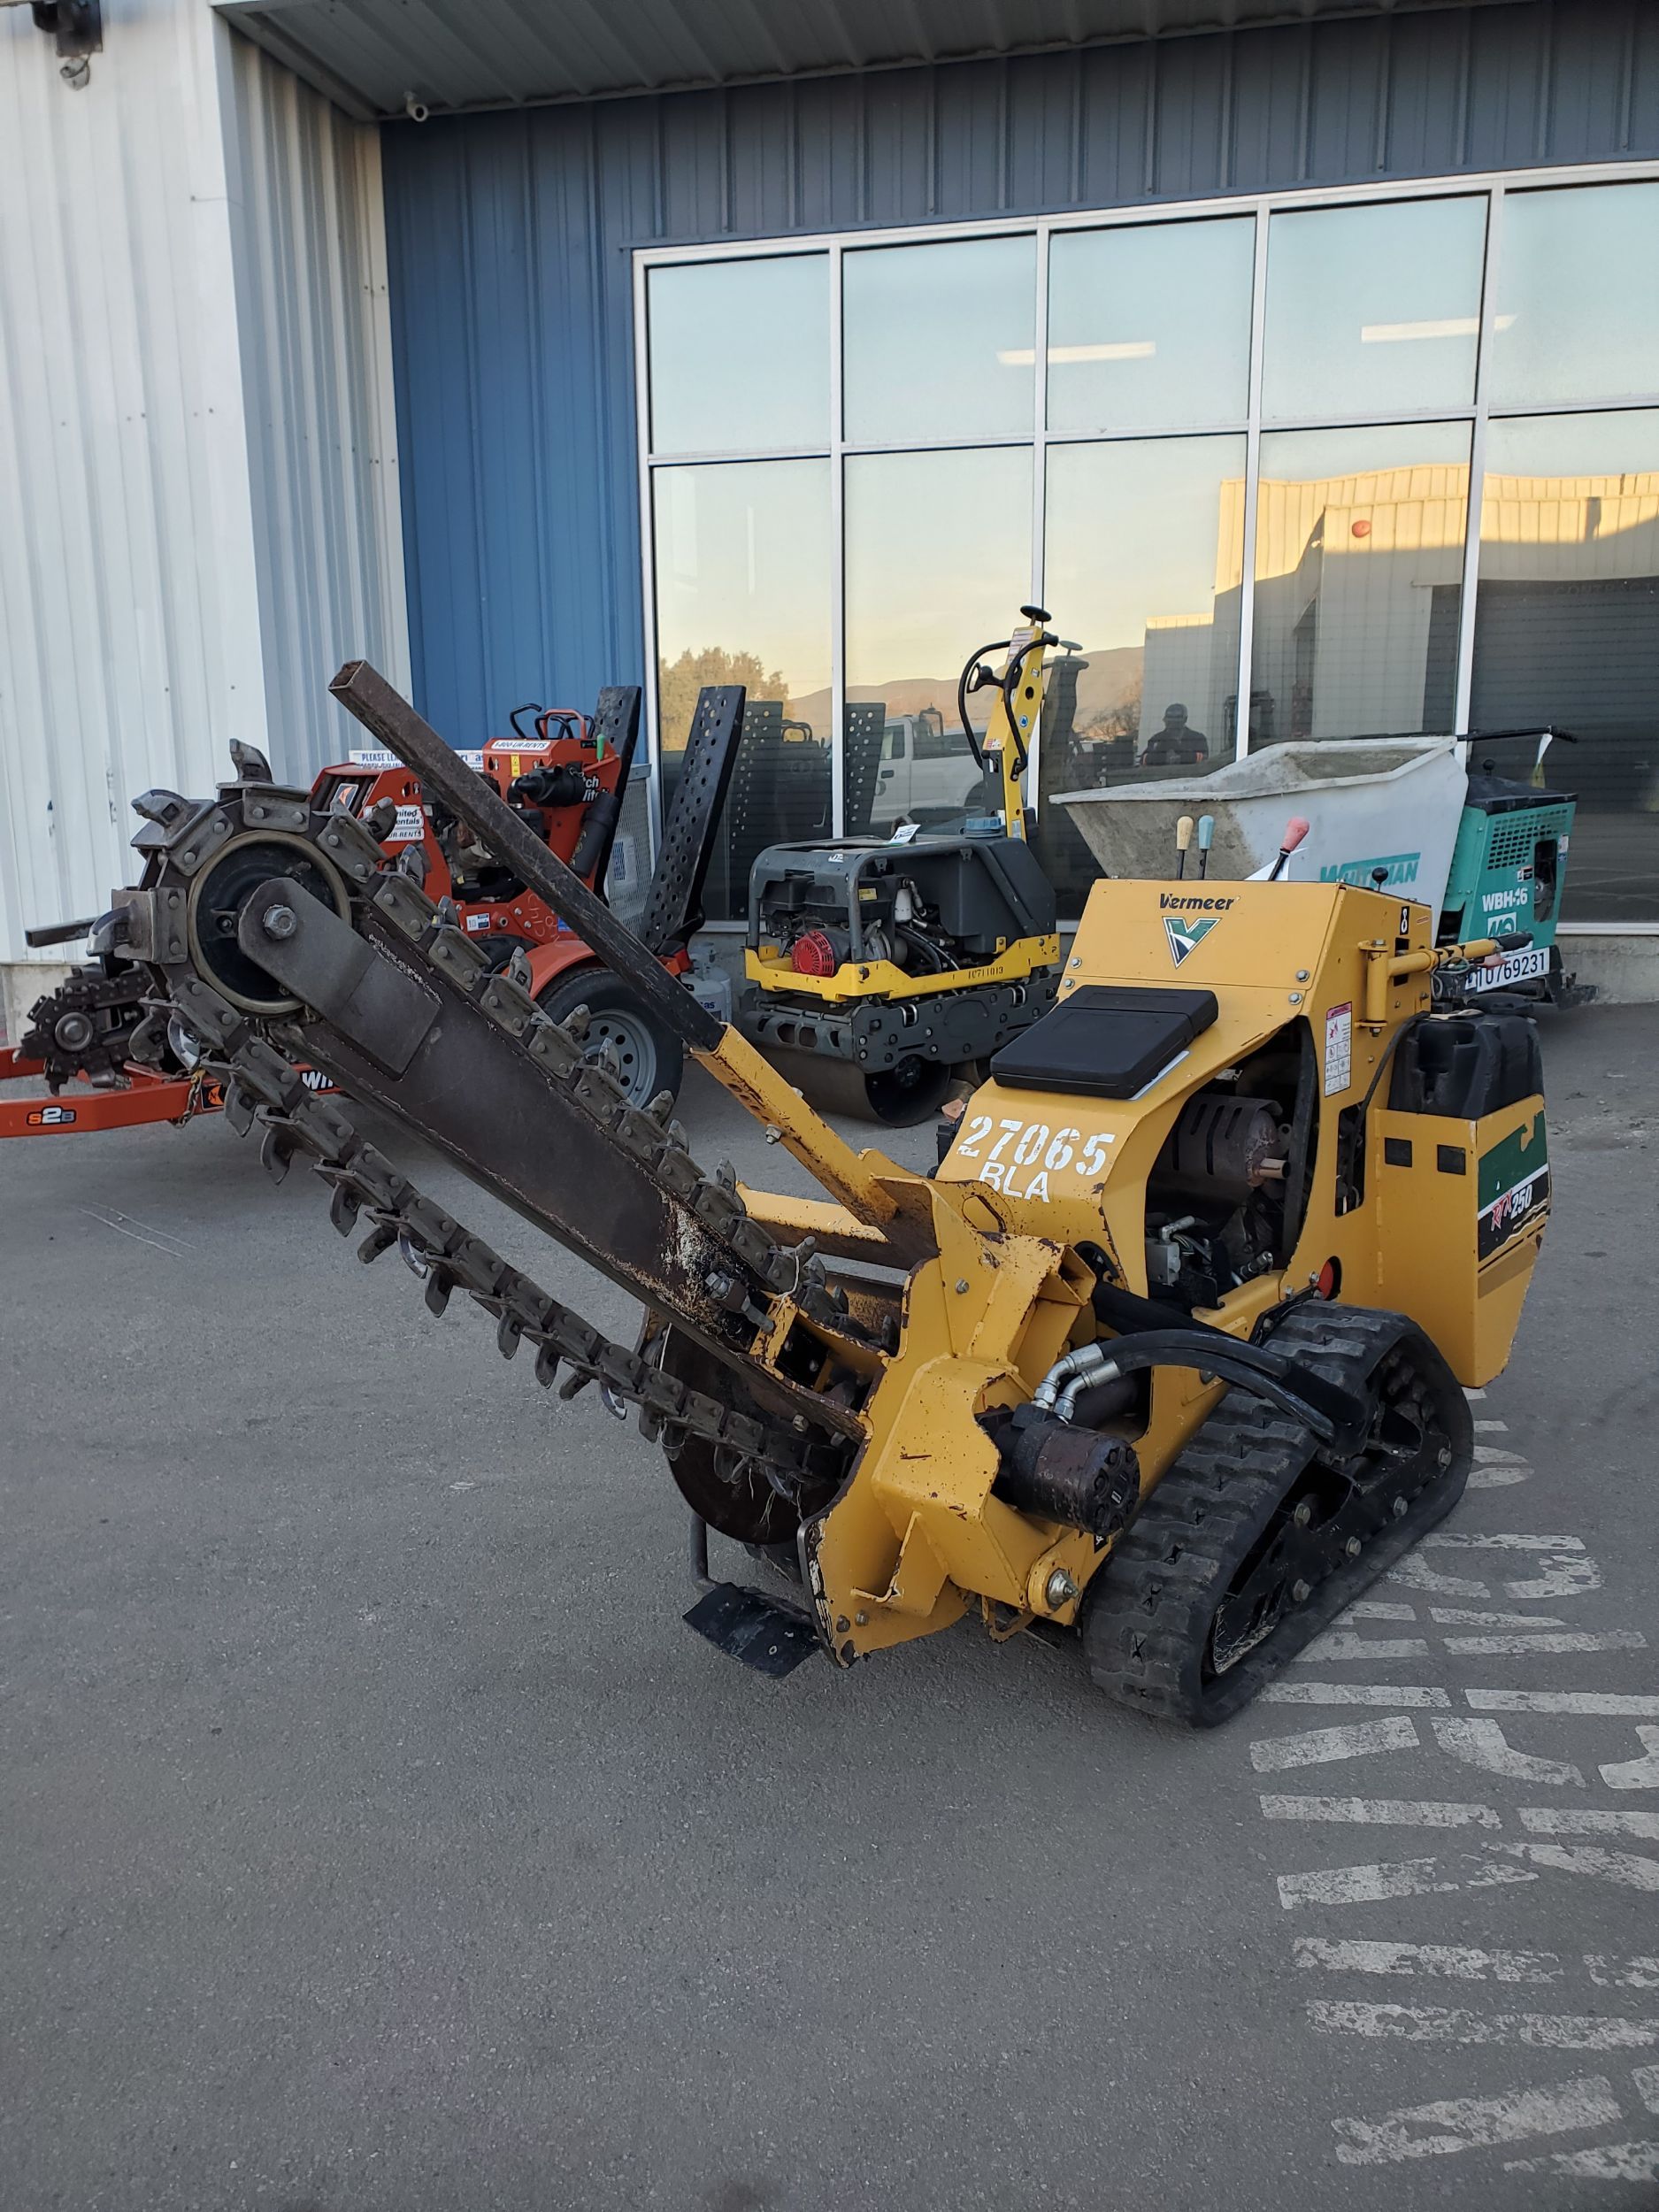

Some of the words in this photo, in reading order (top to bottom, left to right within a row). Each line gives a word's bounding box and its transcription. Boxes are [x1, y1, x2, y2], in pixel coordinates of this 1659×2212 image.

[361, 753, 385, 762] PLEASE
[396, 817, 420, 826] entals
[1160, 893, 1234, 910] Vermeer
[956, 1116, 1116, 1176] 27065
[979, 1161, 1050, 1203] BLA
[1510, 1183, 1533, 1220] 250
